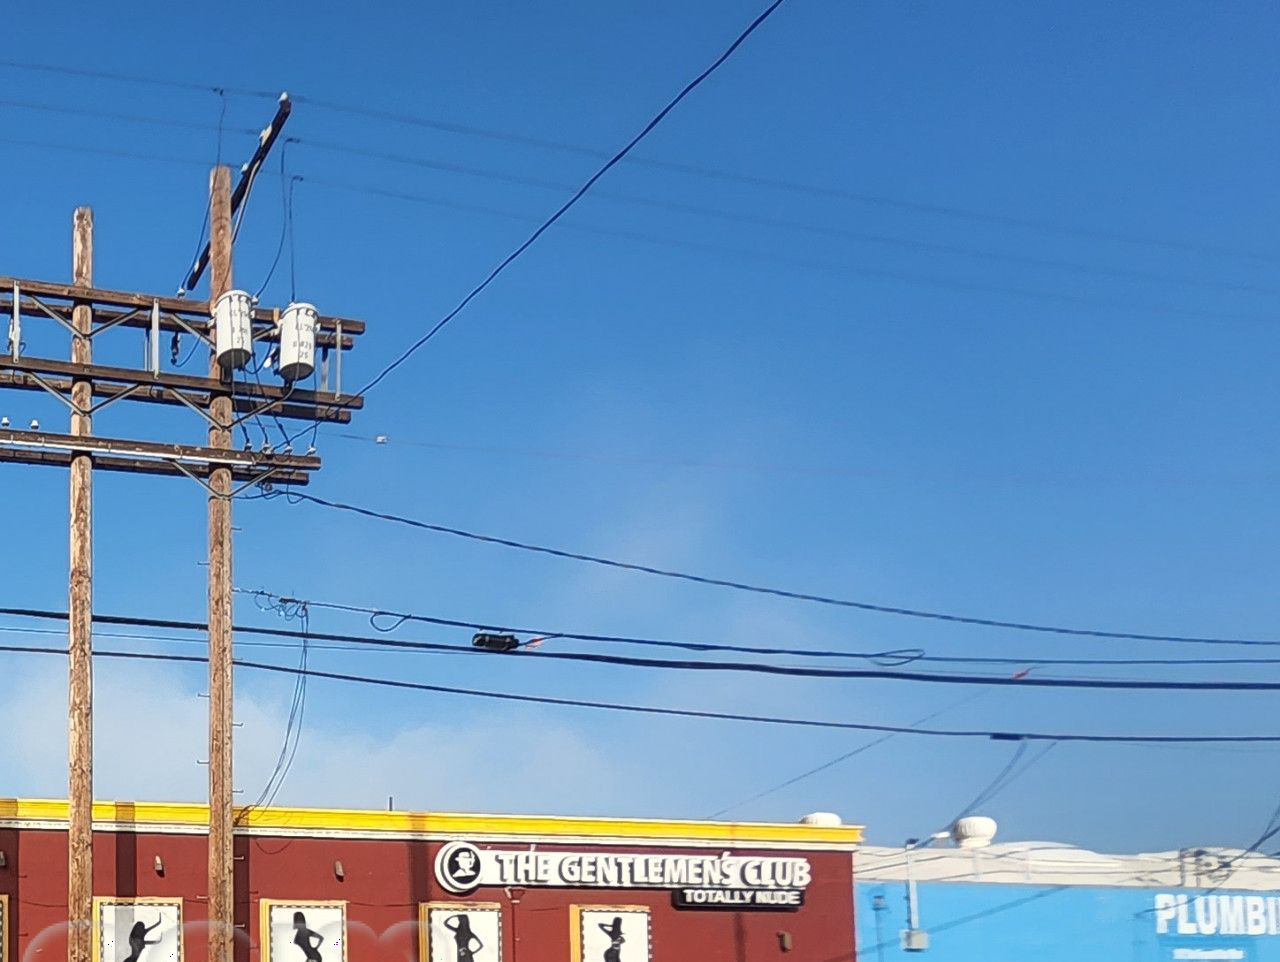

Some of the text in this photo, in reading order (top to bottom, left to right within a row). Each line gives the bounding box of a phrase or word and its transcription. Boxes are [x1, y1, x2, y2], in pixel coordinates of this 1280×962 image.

[495, 853, 549, 881] THE
[741, 859, 812, 889] CLUB
[683, 889, 802, 905] TOTALLY NUDE
[1155, 894, 1280, 935] PLUMBI
